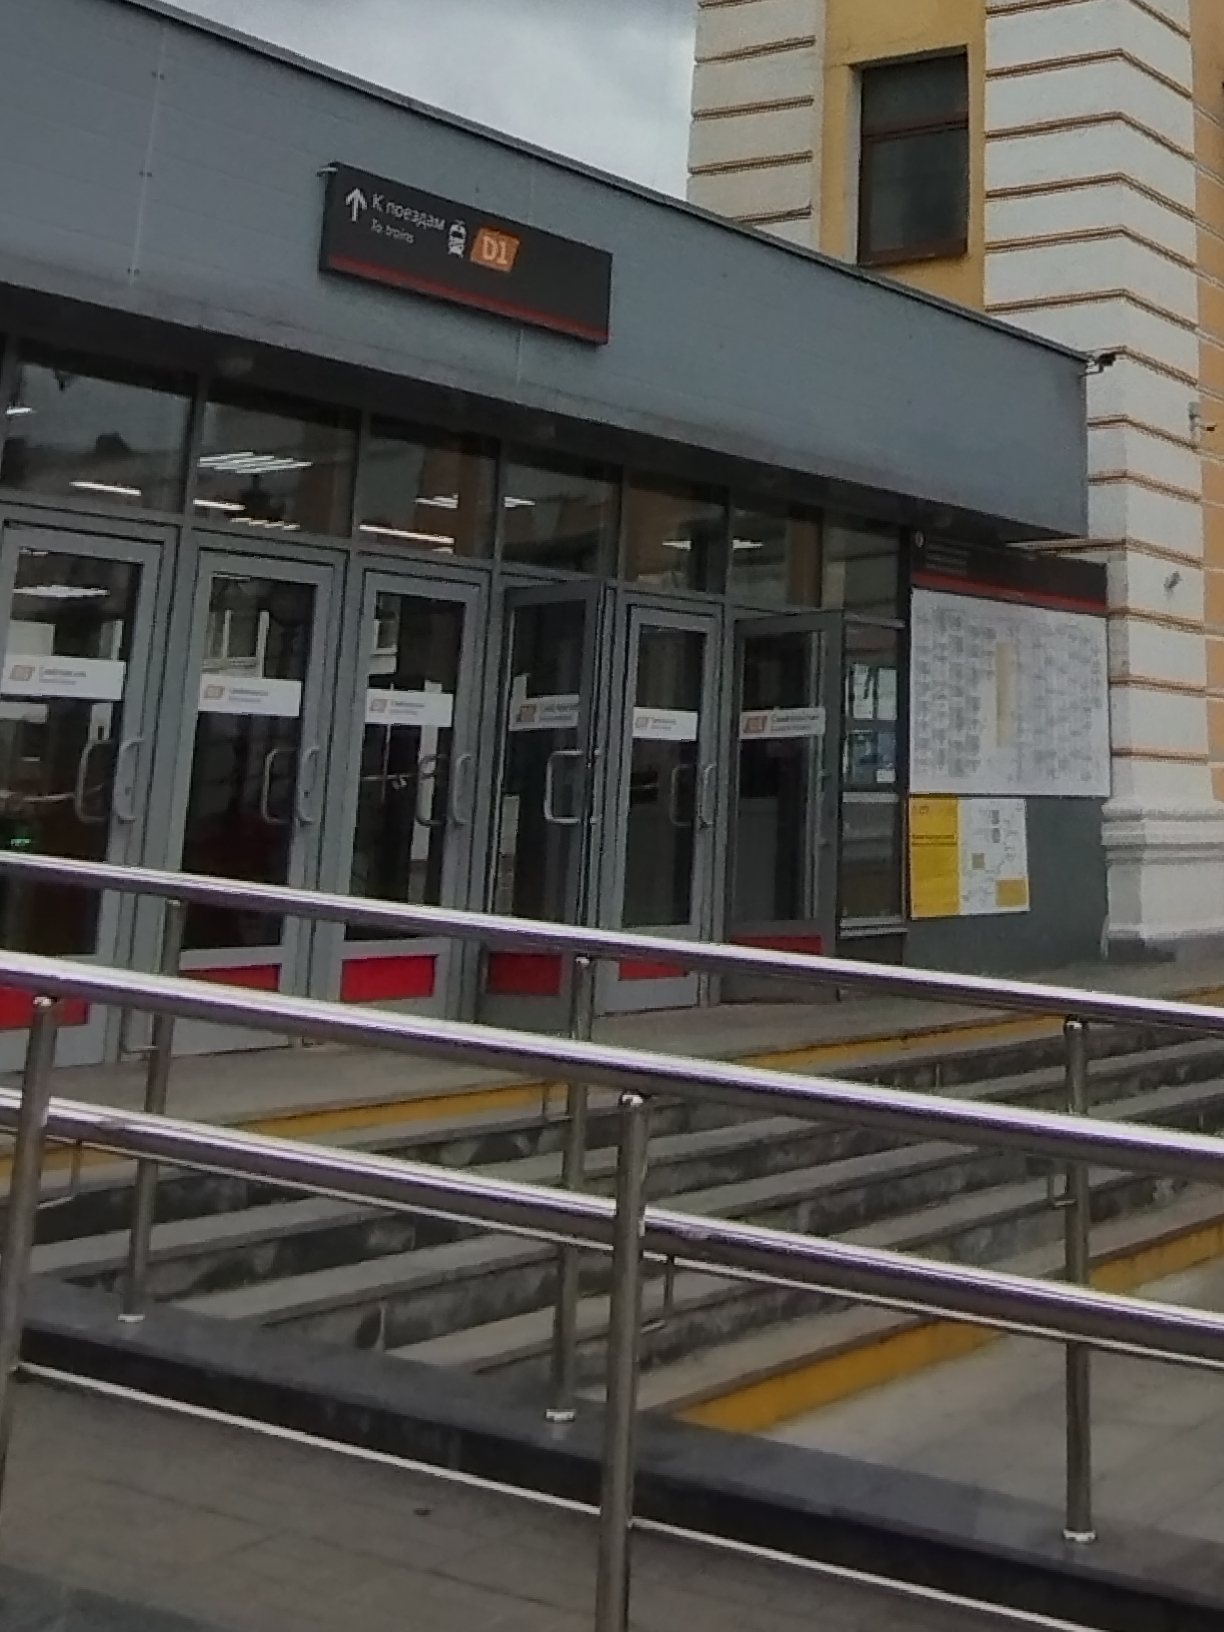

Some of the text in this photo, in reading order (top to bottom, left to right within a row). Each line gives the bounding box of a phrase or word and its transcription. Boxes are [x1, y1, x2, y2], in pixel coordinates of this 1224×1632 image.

[371, 218, 383, 233] To
[372, 193, 446, 230] К поездам
[482, 235, 508, 265] D1
